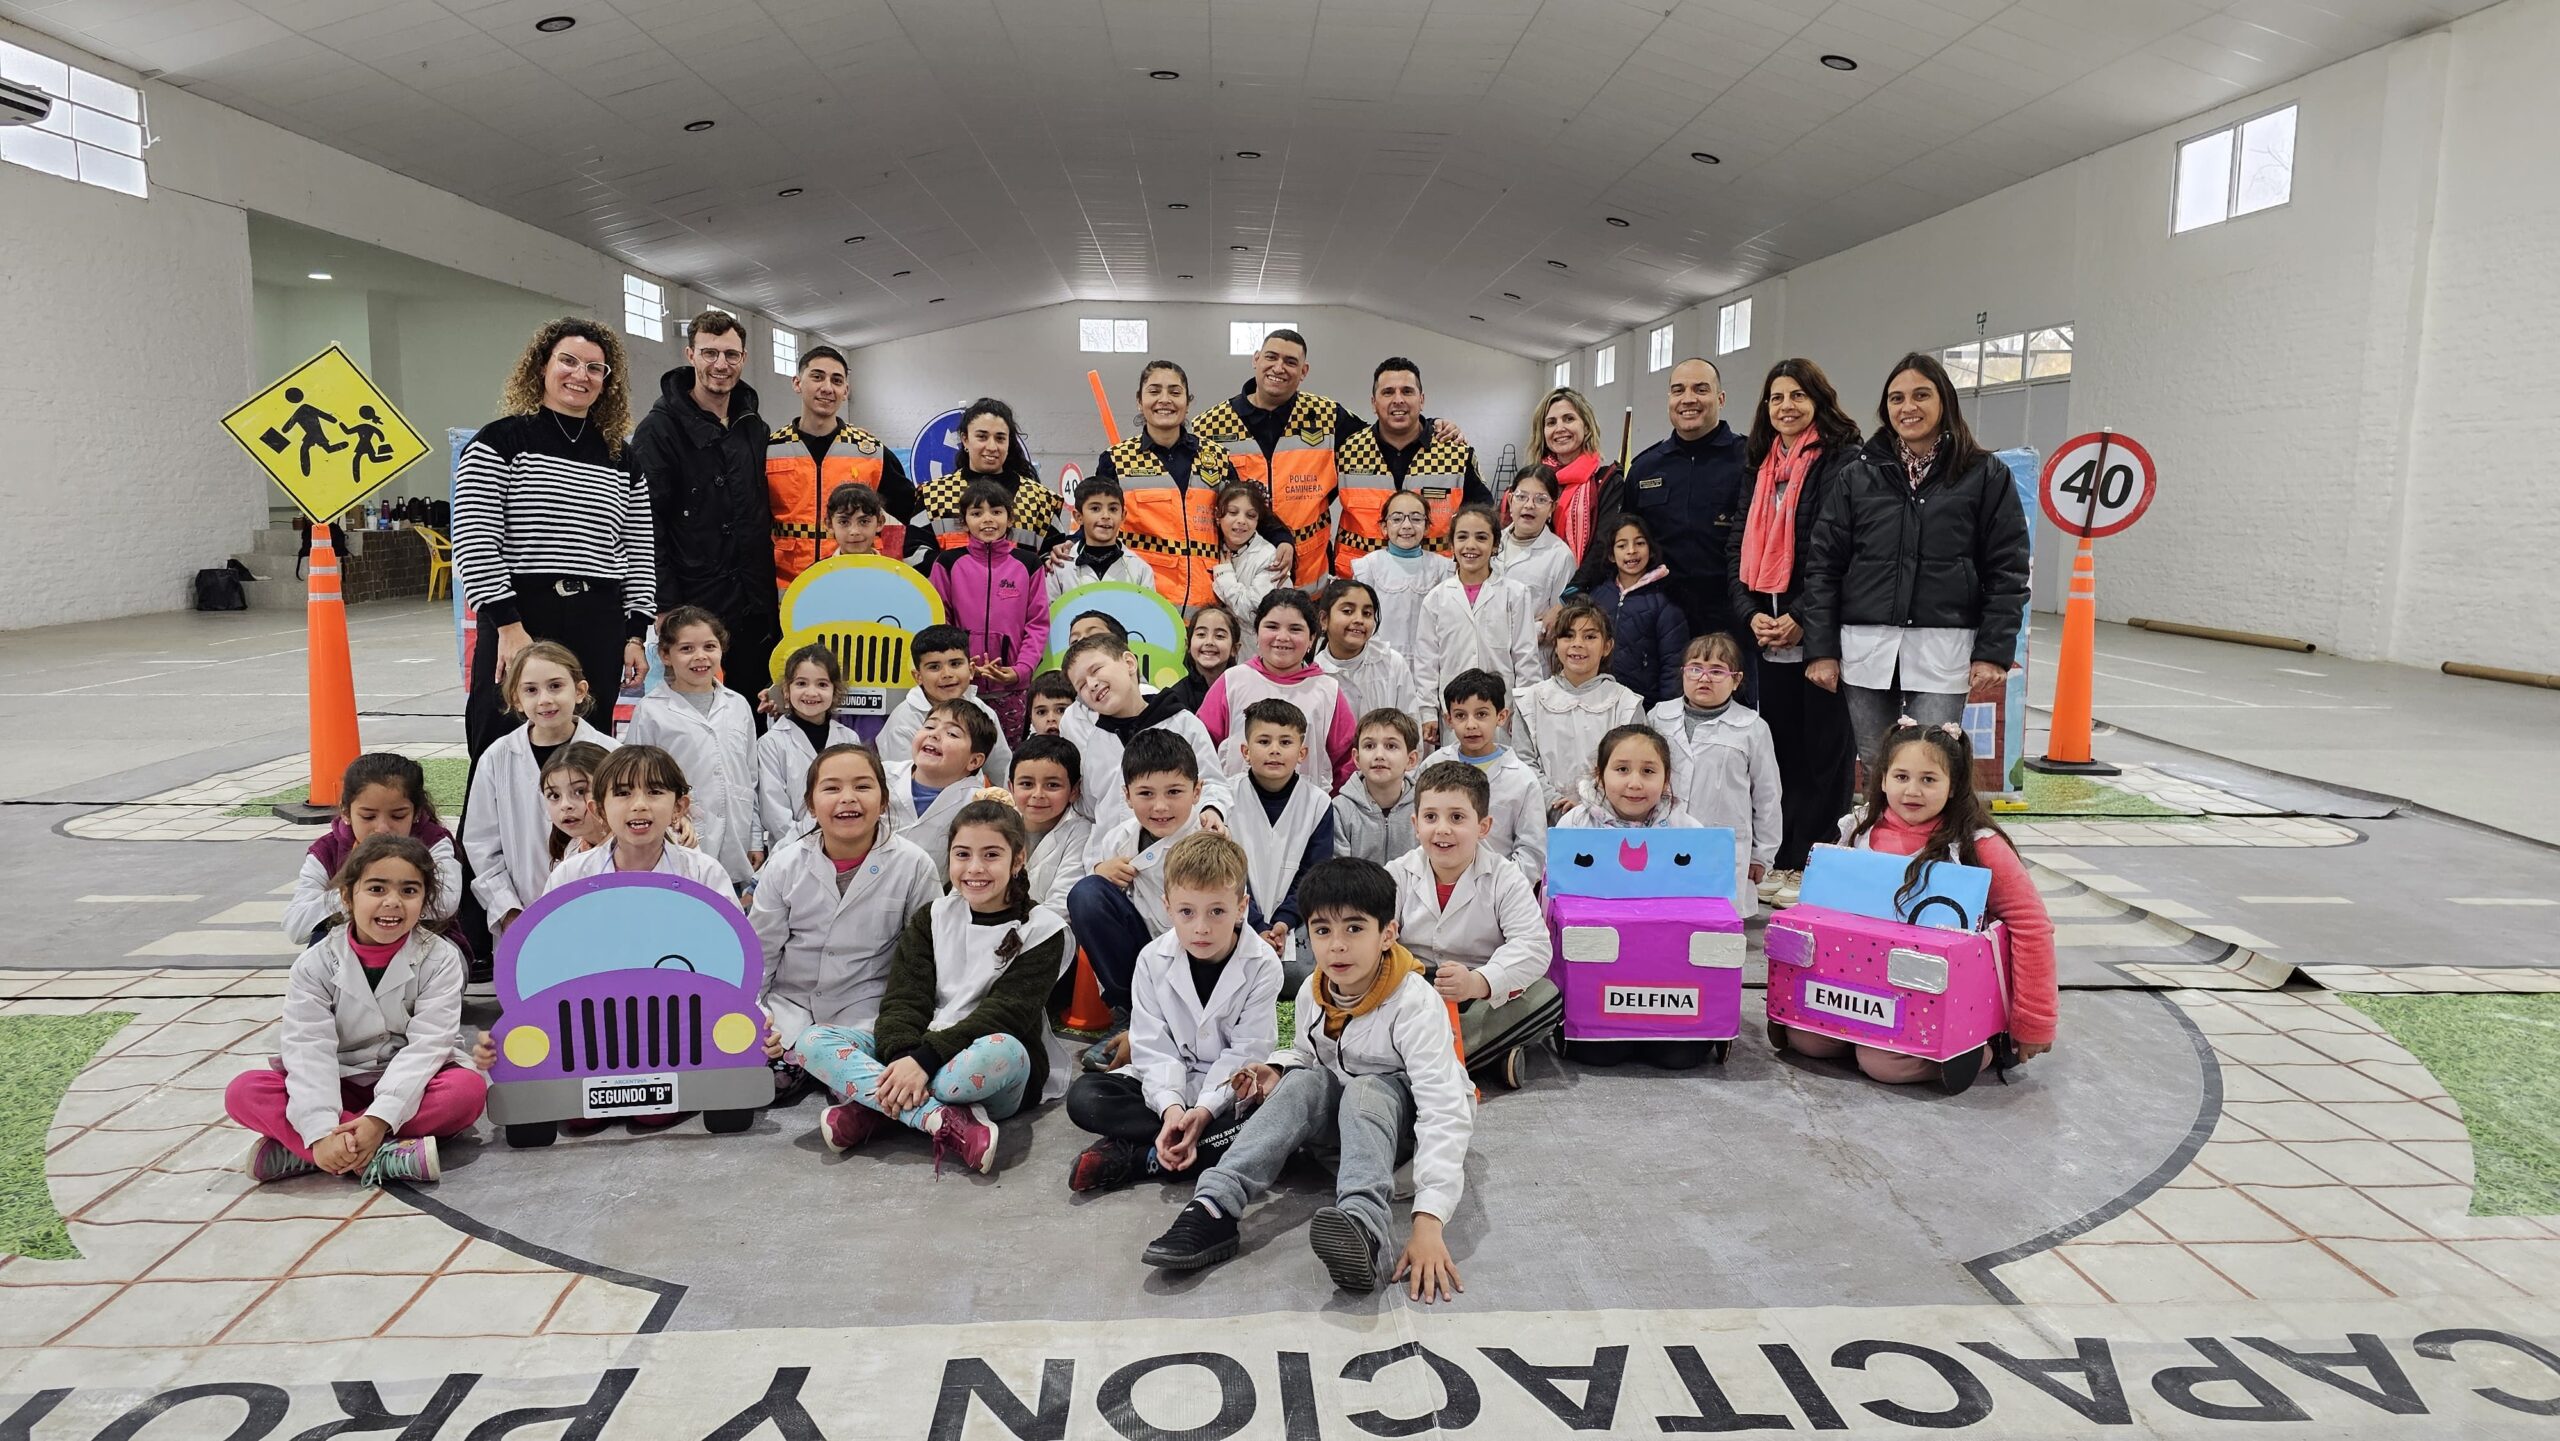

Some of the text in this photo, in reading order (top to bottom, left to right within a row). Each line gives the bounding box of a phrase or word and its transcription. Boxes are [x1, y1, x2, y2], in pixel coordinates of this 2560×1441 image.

[1285, 484, 1323, 493] CAMINERA
[2060, 459, 2134, 509] 40
[1610, 992, 1694, 1008] DELFINA
[1815, 987, 1884, 1019] EMILIA
[590, 1086, 671, 1105] SEGUNDO "B"
[1211, 1137, 1229, 1149] COOL
